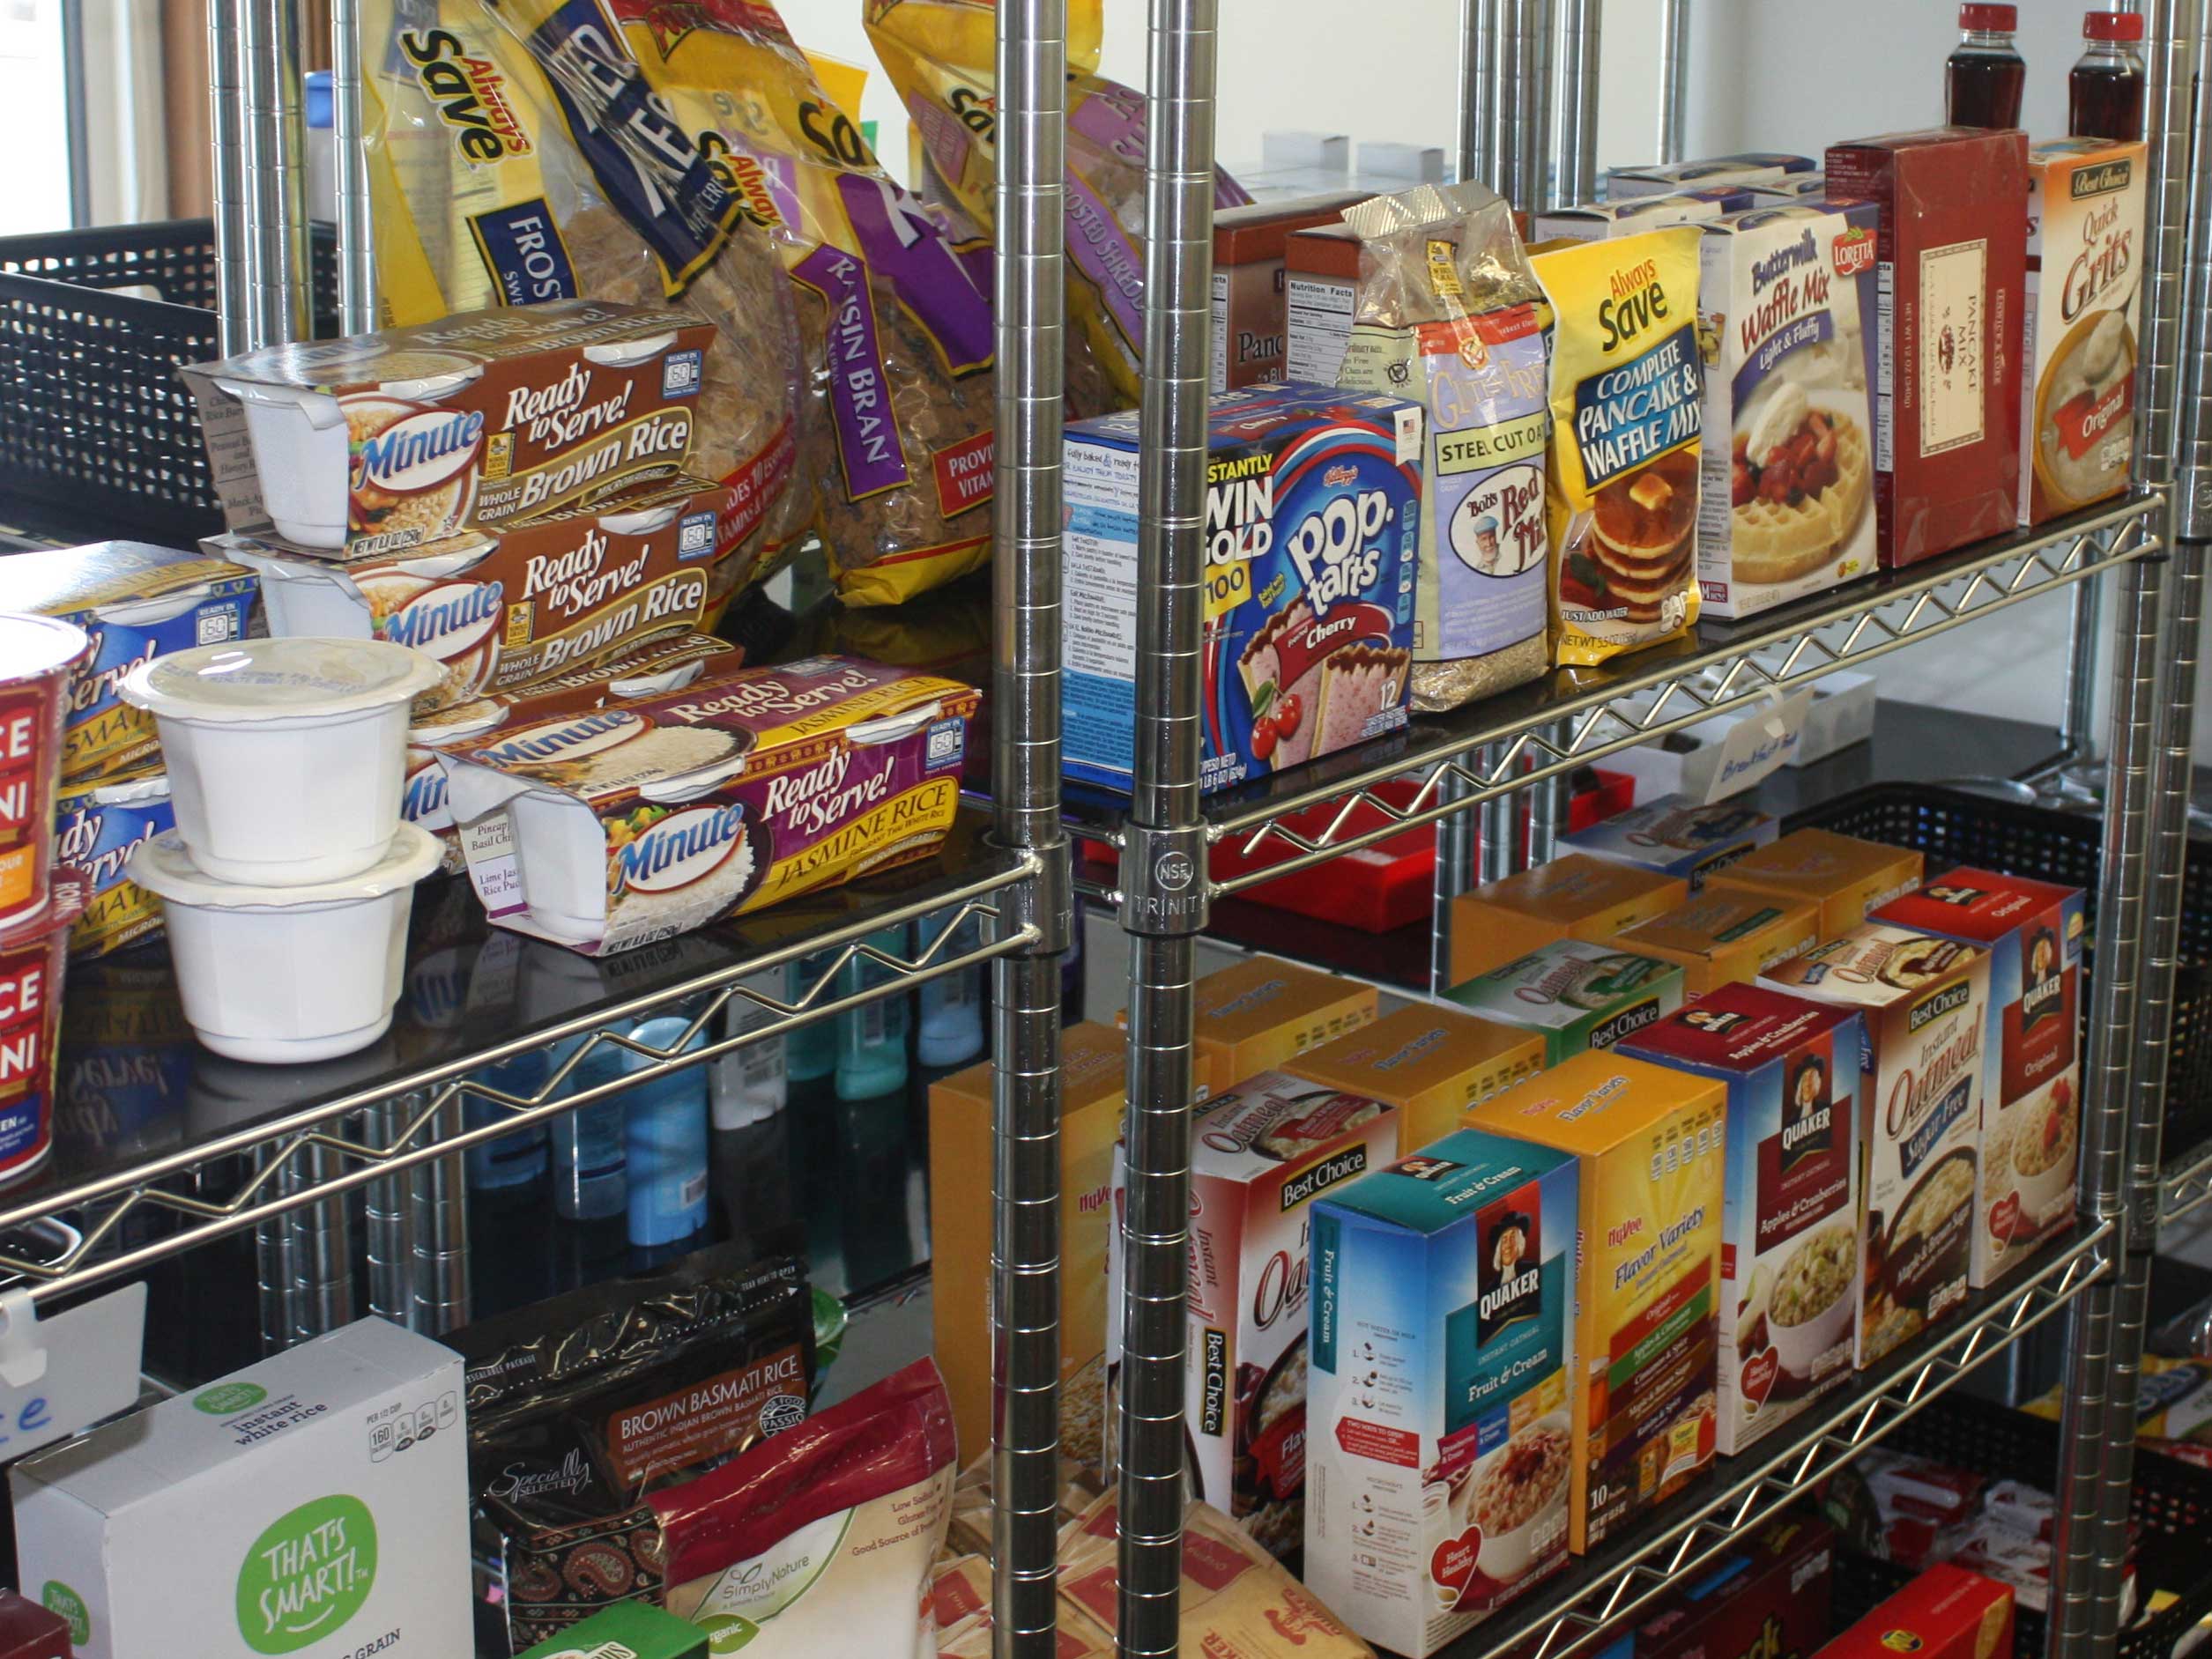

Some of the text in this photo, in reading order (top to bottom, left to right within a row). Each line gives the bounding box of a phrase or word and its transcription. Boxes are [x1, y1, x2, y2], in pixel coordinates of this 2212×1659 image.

[402, 29, 504, 159] Save
[462, 56, 531, 153] Always
[730, 155, 781, 220] Alway
[2082, 196, 2119, 246] Quick
[1609, 257, 1657, 301] Always
[1751, 227, 1817, 297] Buttermilk
[1835, 240, 1875, 268] LORETTA
[2061, 227, 2133, 325] Grits
[1290, 281, 1353, 299] Nutrition Facts
[1598, 281, 1668, 352] Save
[1741, 265, 1831, 353] Waffle Mix
[1793, 316, 1821, 344] Fluffy
[1957, 325, 1968, 367] MIX
[827, 257, 890, 464] RAISIN BRAN
[1597, 339, 1681, 401] COMPLETE
[503, 361, 591, 430] Ready
[529, 379, 635, 451] to Serve!
[1578, 363, 1698, 442] PANCAKE &
[2082, 382, 2125, 438] Original
[354, 410, 485, 492] Minute
[518, 441, 625, 511] Brown
[627, 416, 688, 462] Rice
[1441, 431, 1525, 463] STEEL CUT
[1582, 400, 1703, 480] WAFFLE MIX
[1207, 453, 1273, 484] STANTLY
[477, 502, 517, 522] GRAIN
[478, 486, 522, 507] WHOLE
[1206, 475, 1273, 530] WIN
[1467, 493, 1498, 519] Bob's
[1501, 465, 1540, 532] Red
[521, 529, 608, 601] Ready
[1206, 521, 1273, 566] OLD
[547, 543, 650, 618] to Serve!
[384, 580, 504, 649] Minute
[538, 602, 638, 674] Brown
[642, 578, 703, 622] Rice
[1306, 616, 1357, 649] Cherry
[496, 668, 534, 687] GRAIN
[499, 652, 541, 675] WHOLE
[663, 679, 791, 724] Ready
[767, 668, 879, 715] Serve!
[789, 676, 937, 736] JASMINE RICE
[1379, 678, 1398, 710] 12
[472, 709, 641, 769] Minute
[761, 744, 852, 823] Ready
[789, 755, 895, 836] to Serve!
[471, 834, 496, 852] Basil
[612, 803, 745, 896] Minute
[776, 782, 950, 892] JASMINE RICE
[479, 871, 501, 886] Lime
[483, 883, 502, 898] Rice
[1910, 986, 1969, 1031] Best Choice
[2023, 974, 2061, 1014] QUAKER
[1591, 1004, 1659, 1049] Best Choice
[1887, 1001, 1984, 1140] Oatmeal
[1202, 1092, 1292, 1154] Oatmeal
[1782, 1107, 1832, 1150] QUAKER
[1283, 1152, 1365, 1208] Best Choice
[1481, 1166, 1523, 1188] Cream
[1759, 1208, 1792, 1236] Apples
[1800, 1176, 1847, 1212] Cranberries
[1324, 1248, 1335, 1284] Fruit
[1614, 1205, 1707, 1292] Flavor Variety
[1322, 1299, 1334, 1344] Cream
[1480, 1267, 1540, 1322] QUAKER
[620, 1354, 798, 1440] BROWN BASMATI RICE
[1205, 1331, 1224, 1433] Best Choice
[1467, 1376, 1499, 1403] Fruit
[1511, 1347, 1549, 1378] Cream
[233, 1400, 302, 1433] instant
[234, 1403, 329, 1446] white rice
[372, 1426, 390, 1446] 160
[621, 1383, 783, 1454] AUTHENTIC INDIAN BROWN BASMATI RICE
[488, 1447, 592, 1503] Specially
[516, 1475, 577, 1498] SELECTED
[1590, 1484, 1608, 1511] 10
[260, 1516, 347, 1582] THAT'S
[852, 1540, 878, 1557] Good
[878, 1531, 910, 1548] Source
[1441, 1553, 1475, 1581] Healthy
[1445, 1544, 1472, 1566] Heart
[258, 1546, 357, 1635] SMART!
[354, 1627, 402, 1659] GRAIN
[709, 1621, 743, 1644] rganic
